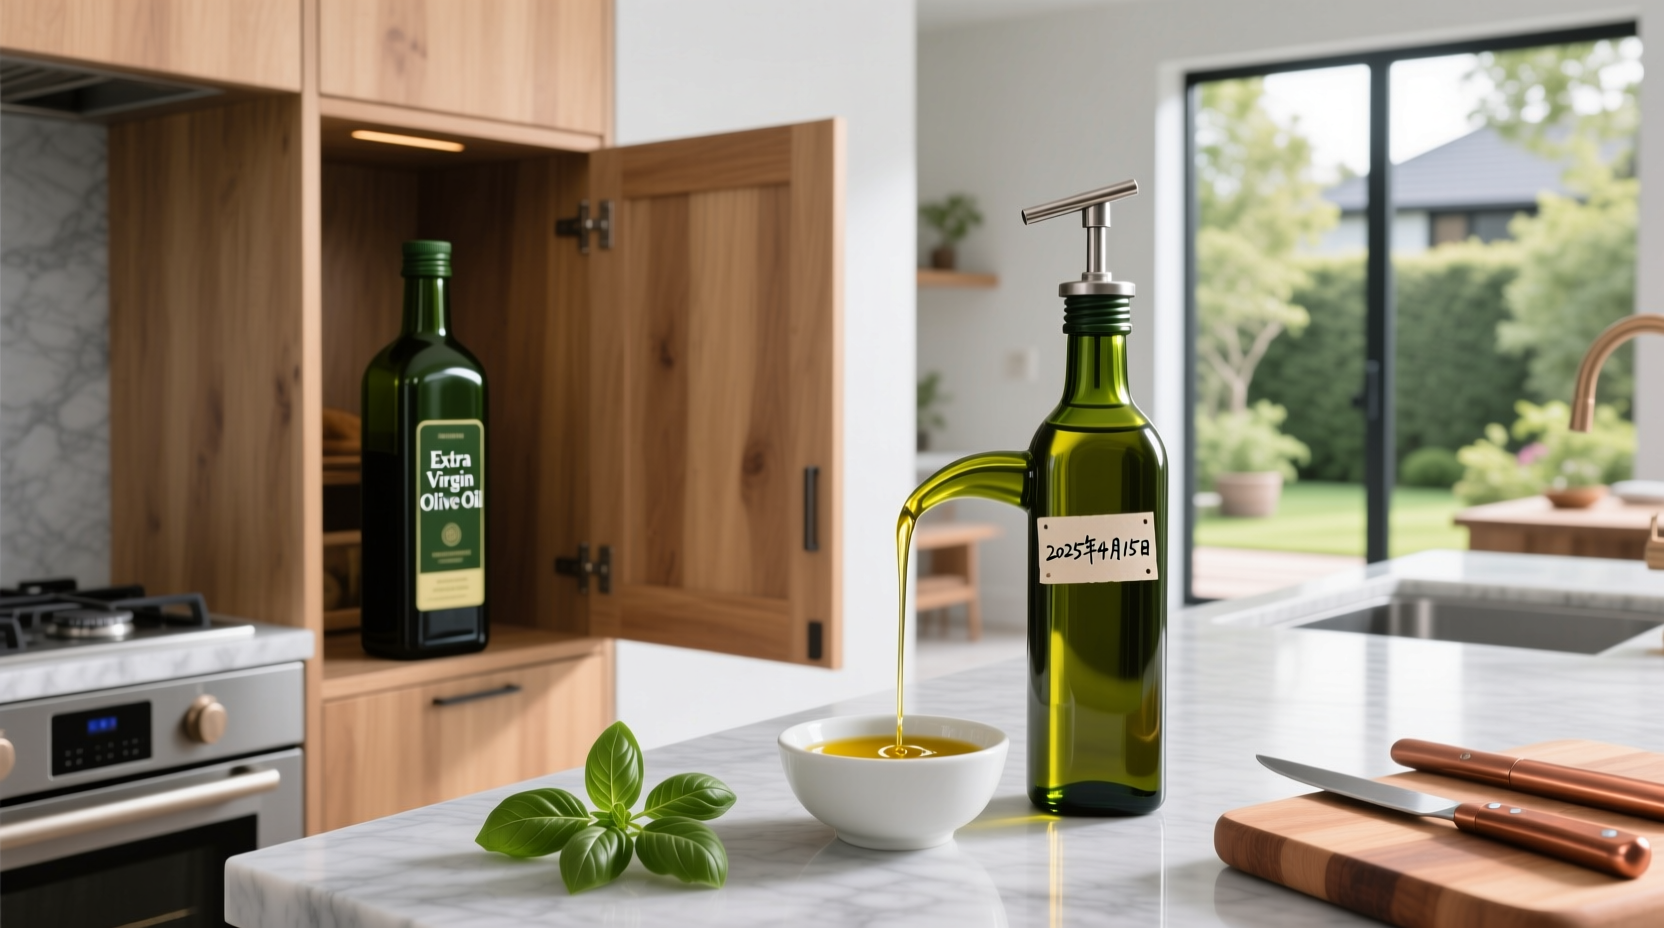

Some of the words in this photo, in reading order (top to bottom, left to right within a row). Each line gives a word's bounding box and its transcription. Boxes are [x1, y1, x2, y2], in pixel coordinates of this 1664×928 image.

[430, 450, 471, 469] Extra
[426, 470, 474, 493] Virgin
[420, 493, 460, 512] Olive
[461, 490, 484, 509] Oil
[1046, 535, 1150, 565] 2025年4月15日
